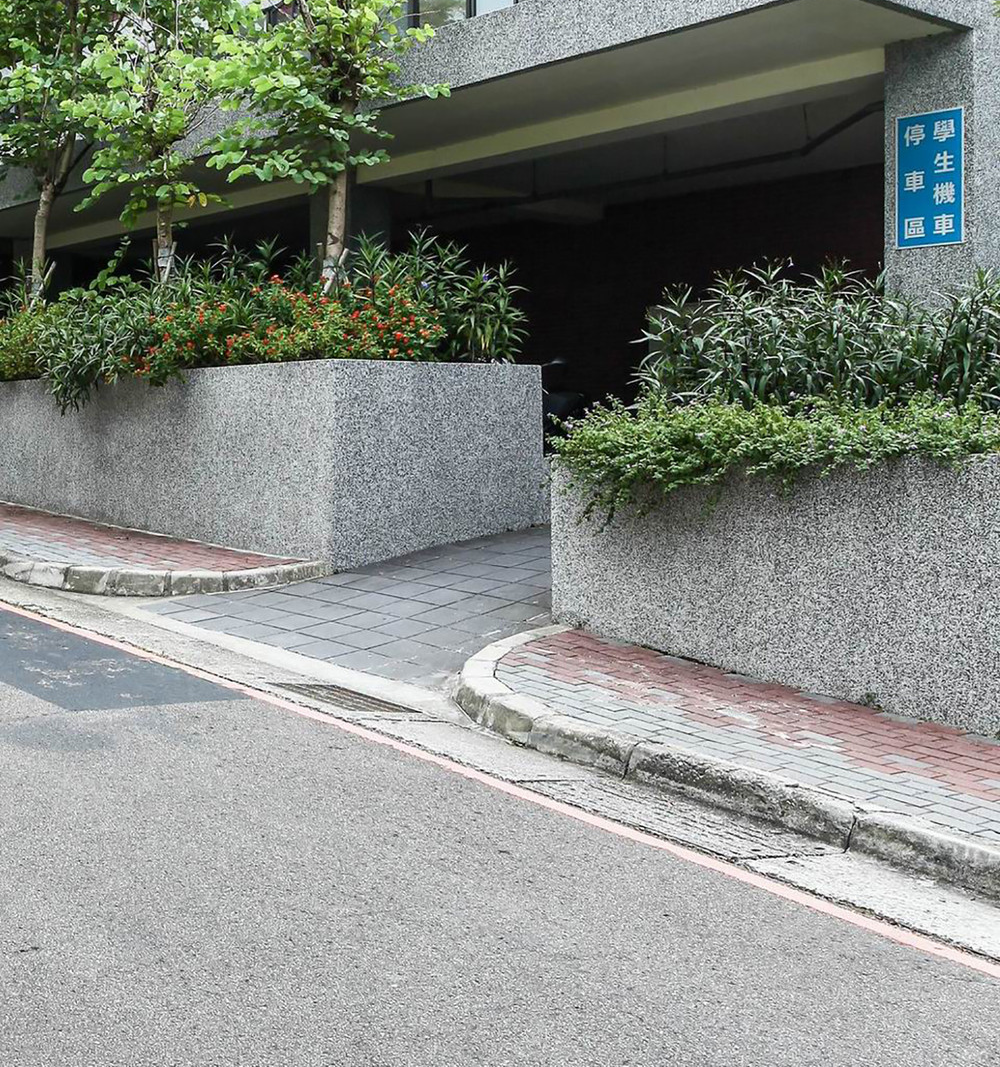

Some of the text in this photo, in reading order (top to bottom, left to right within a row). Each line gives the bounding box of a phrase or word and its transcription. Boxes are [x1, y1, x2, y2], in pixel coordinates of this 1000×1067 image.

[904, 124, 926, 239] 停車區
[933, 119, 955, 236] 學生機車
